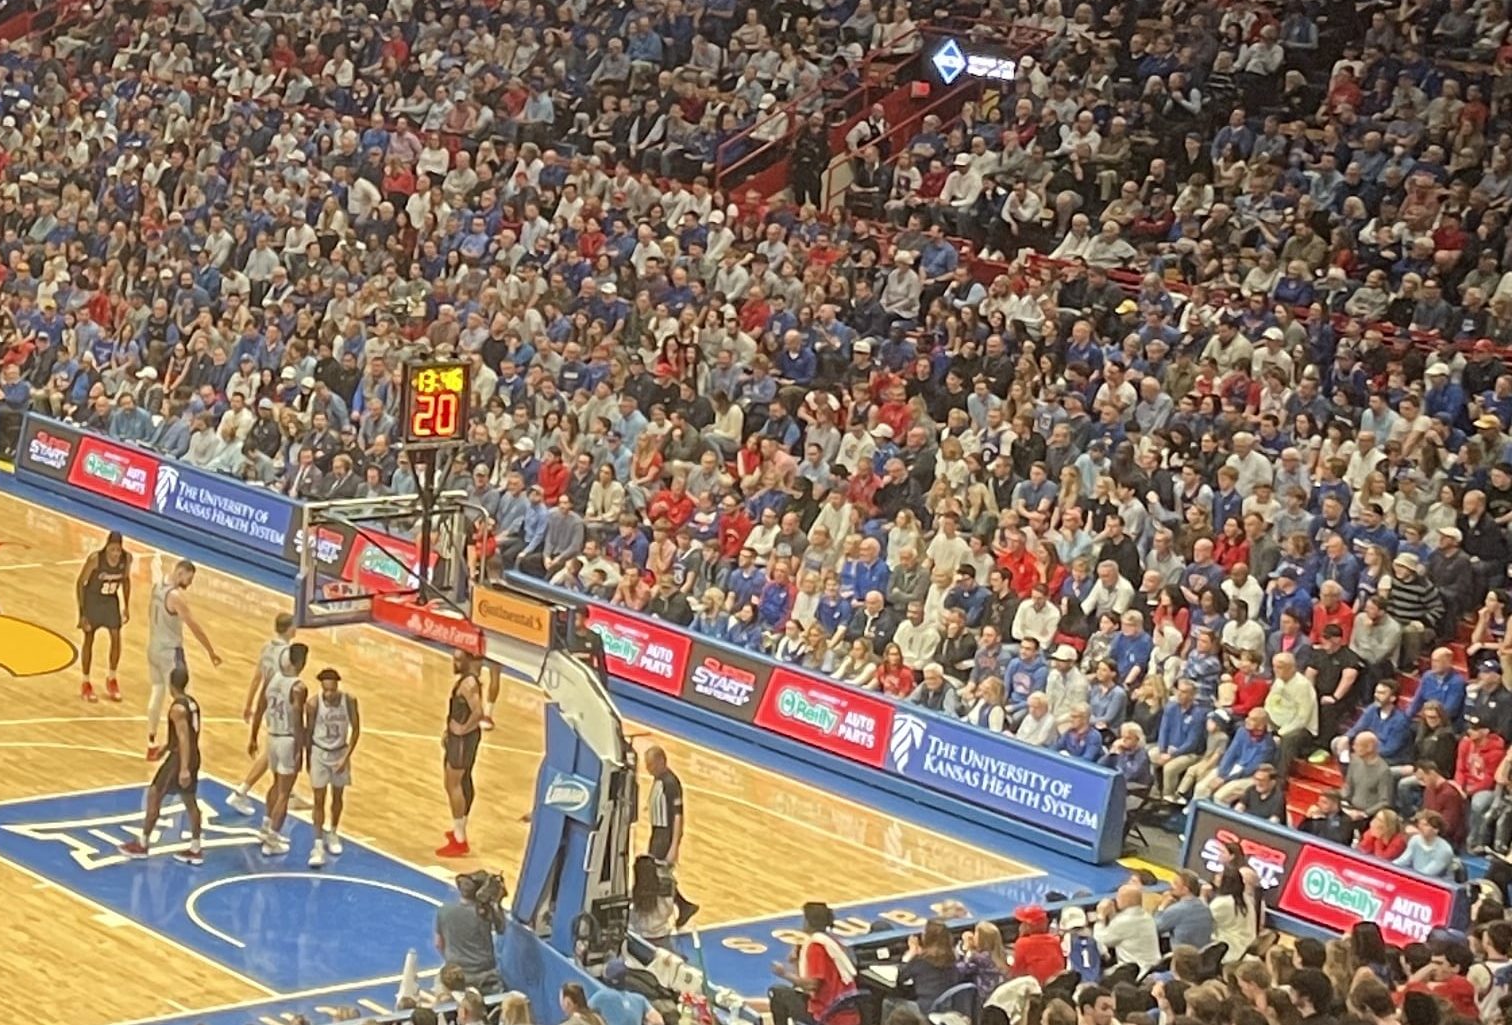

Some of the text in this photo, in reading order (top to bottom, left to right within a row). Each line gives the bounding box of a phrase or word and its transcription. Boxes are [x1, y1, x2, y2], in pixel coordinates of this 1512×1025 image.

[416, 367, 464, 393] 13:46
[412, 393, 458, 437] 20
[178, 480, 269, 524] THE UNIVERSITY OF
[175, 496, 213, 520] KANSAS
[211, 508, 249, 533] HEALTH
[248, 520, 286, 545] SYSTEM
[423, 618, 478, 646] State Farm
[639, 656, 674, 679] PARTS
[645, 643, 674, 662] AUTO
[691, 664, 754, 698] START
[837, 724, 876, 749] PARTS
[844, 709, 876, 732] AUTO
[928, 733, 1074, 800] THE UNIVERSITY OF
[922, 751, 1100, 831] KANSAS HEALTH SYSTEM
[1302, 865, 1385, 922] O'Reilly
[1391, 895, 1433, 924] AUTO
[1382, 911, 1433, 943] PARTS
